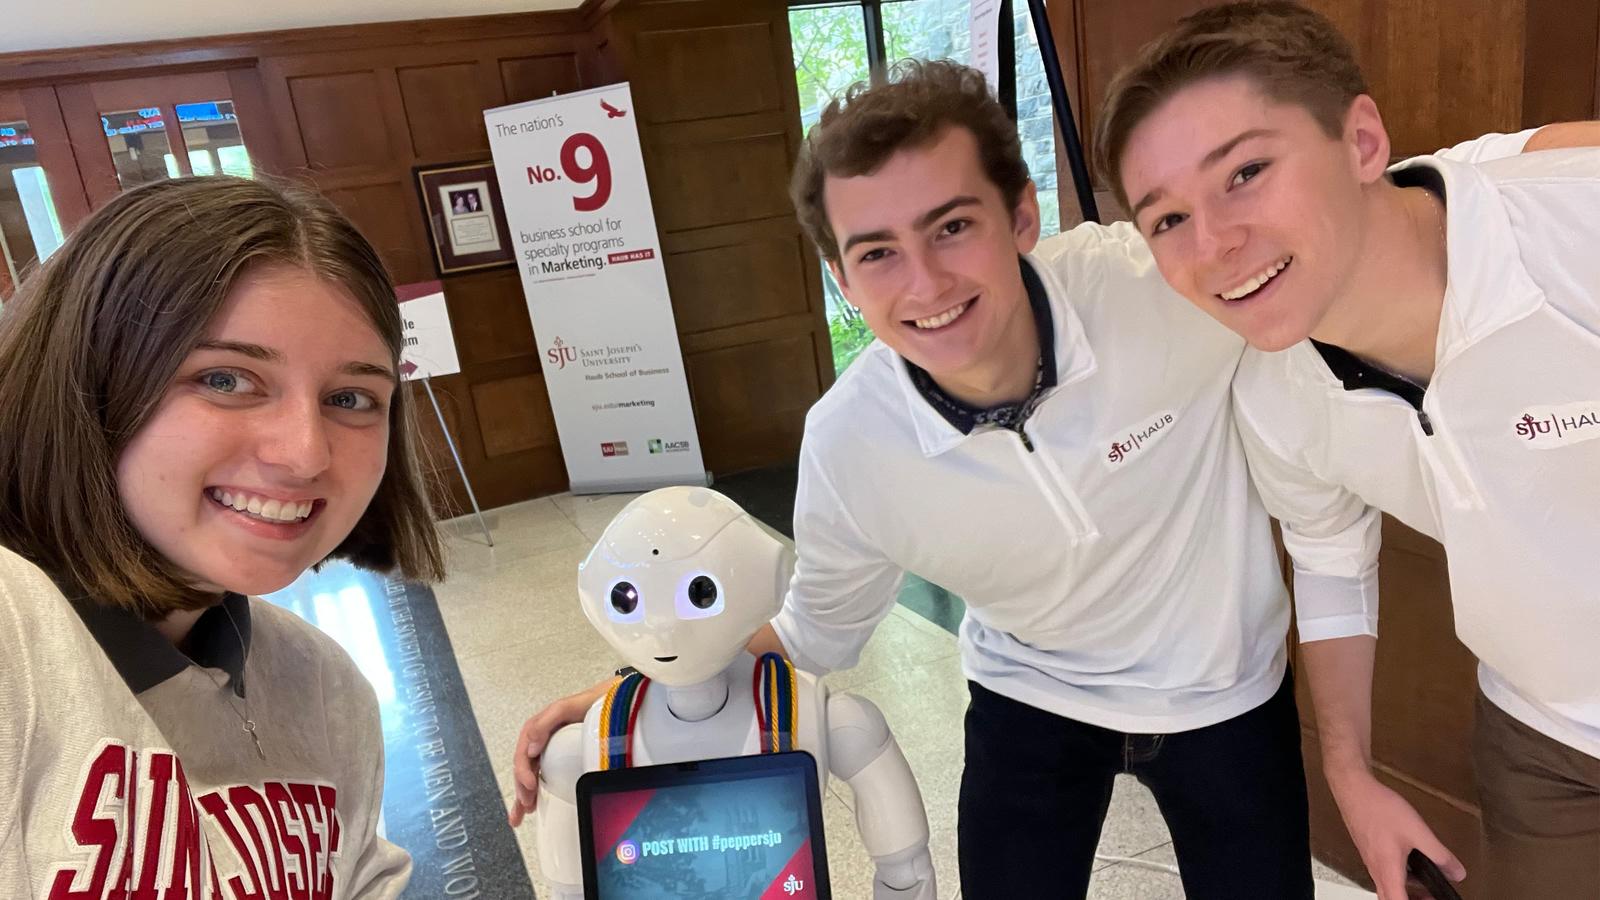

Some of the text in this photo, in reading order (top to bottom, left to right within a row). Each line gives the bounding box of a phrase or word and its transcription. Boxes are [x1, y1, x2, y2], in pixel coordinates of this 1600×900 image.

[495, 113, 564, 138] The nation's
[527, 132, 612, 212] No. 9
[520, 217, 622, 244] business school for
[524, 236, 625, 262] specialty programs
[630, 252, 644, 260] HAS
[528, 254, 607, 276] in Marketing.
[547, 343, 578, 370] SJU
[582, 357, 632, 368] UNIVERSITY
[604, 370, 628, 380] School
[1108, 414, 1173, 463] SJU HAUB
[1516, 416, 1551, 440] SJU
[415, 738, 446, 761] BE
[420, 760, 457, 803] MEN
[430, 804, 469, 851] AND
[642, 829, 782, 857] POST WITH #peppersju
